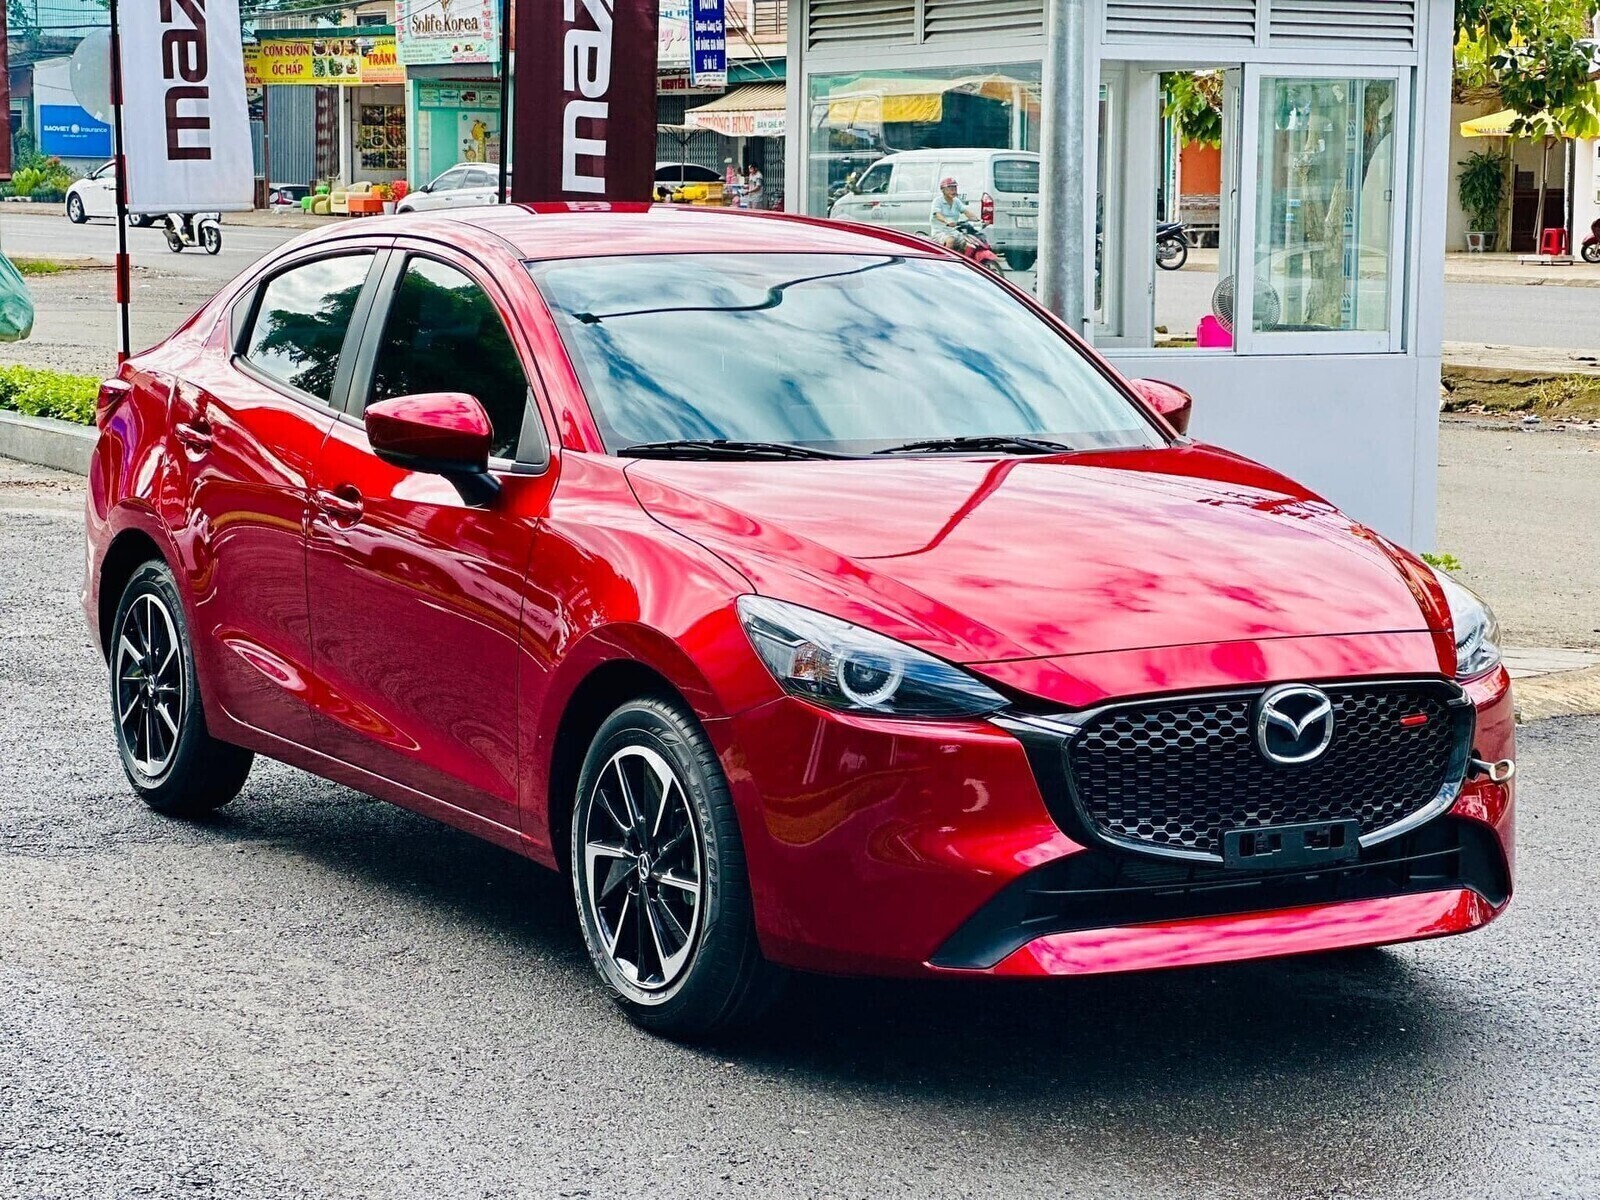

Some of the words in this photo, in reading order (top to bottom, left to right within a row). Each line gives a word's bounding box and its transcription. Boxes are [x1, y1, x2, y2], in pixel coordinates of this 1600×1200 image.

[412, 14, 442, 32] Solife
[444, 14, 478, 32] Korea
[263, 43, 283, 57] CƠM
[272, 60, 285, 75] ỐC
[286, 59, 303, 75] HẤP
[691, 781, 719, 899] DUNLOP
